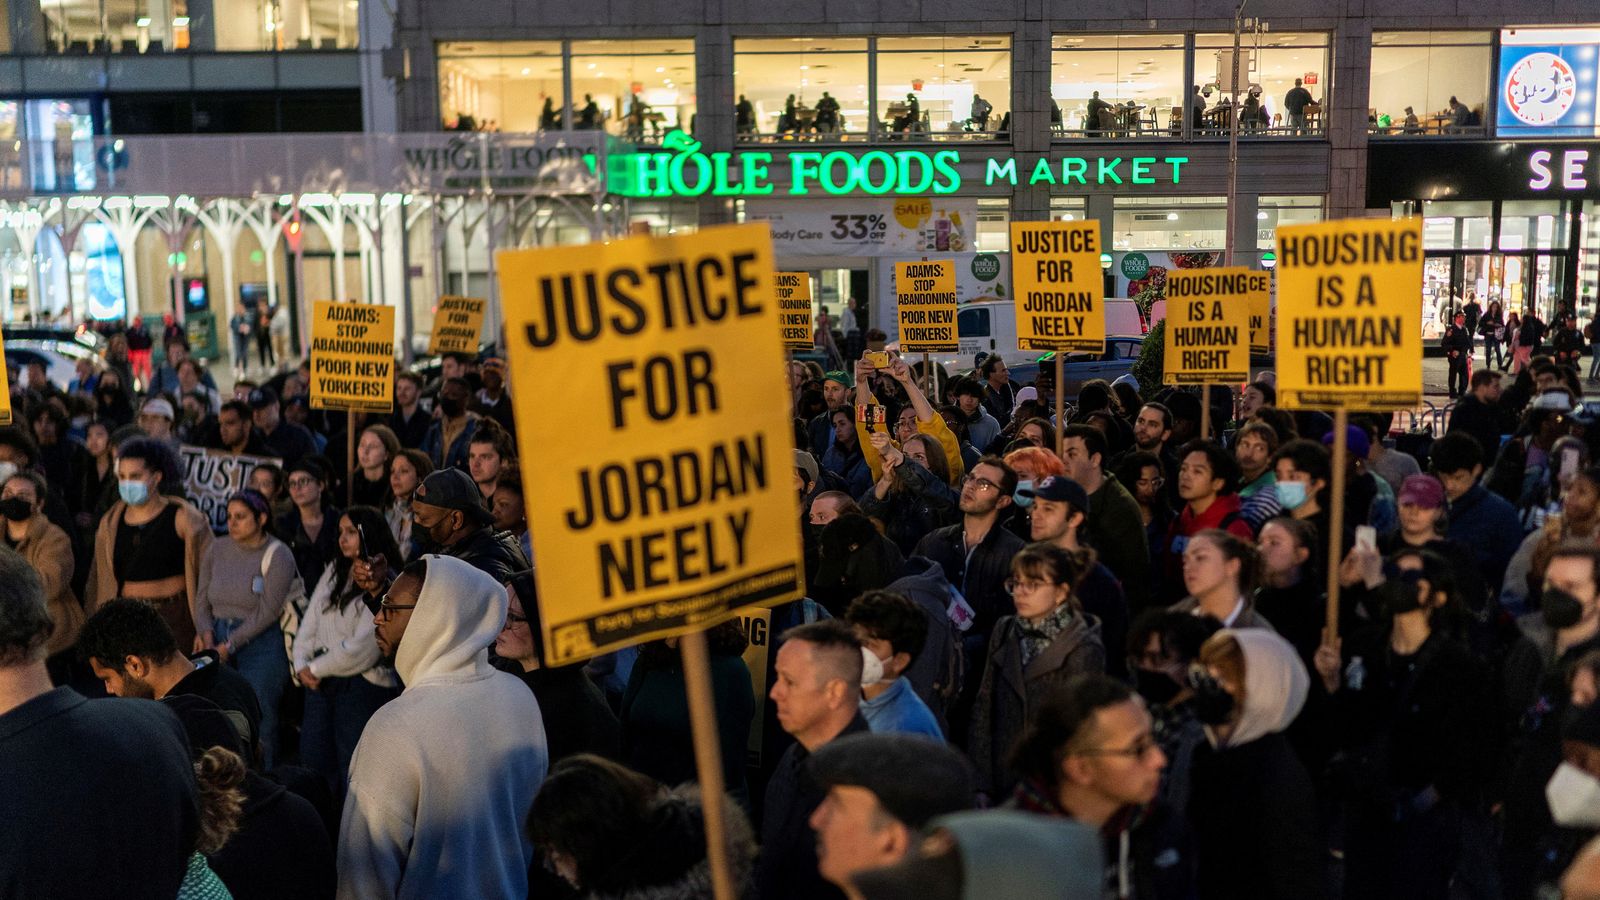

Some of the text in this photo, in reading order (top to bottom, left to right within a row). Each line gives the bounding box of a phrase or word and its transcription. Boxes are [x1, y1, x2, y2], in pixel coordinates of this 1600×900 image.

[582, 147, 1189, 197] HOLE FOODS MARKET
[895, 203, 929, 216] SALE
[770, 230, 823, 243] Body Care
[830, 214, 887, 240] 33%
[869, 232, 886, 240] OFF
[1016, 229, 1095, 254] JUSTICE
[1280, 230, 1419, 268] HOUSING
[974, 258, 998, 267] WHOLE
[1124, 257, 1147, 266] WHOLE
[776, 275, 800, 287] AMS:
[906, 265, 944, 278] ADAMS:
[1036, 260, 1073, 283] FOR
[777, 288, 794, 298] TOP
[913, 280, 935, 292] STOP
[1168, 273, 1247, 297] HOUSING
[1316, 274, 1376, 308] IS A
[524, 251, 764, 349] JUSTICE
[780, 299, 811, 310] DONING
[898, 292, 956, 306] ABANDONING
[1023, 291, 1093, 313] JORDAN
[326, 305, 381, 324] ADAMS:
[787, 314, 809, 325] NEW
[901, 310, 953, 324] POOR NEW
[1188, 301, 1224, 322] IS A
[337, 324, 368, 338] STOP
[783, 327, 809, 339] KERS!
[904, 327, 952, 341] YORKERS!
[1032, 316, 1085, 337] NEELY
[1293, 315, 1403, 348] HUMAN
[1174, 326, 1238, 347] HUMAN
[312, 337, 393, 356] ABANDONING
[316, 358, 389, 377] POOR NEW
[1182, 350, 1230, 370] RIGHT
[1306, 354, 1389, 386] RIGHT
[318, 378, 385, 397] YORKERS!
[605, 348, 720, 430] FOR
[180, 451, 257, 490] JUST
[564, 432, 768, 531] JORDAN
[597, 507, 751, 601] NEELY
